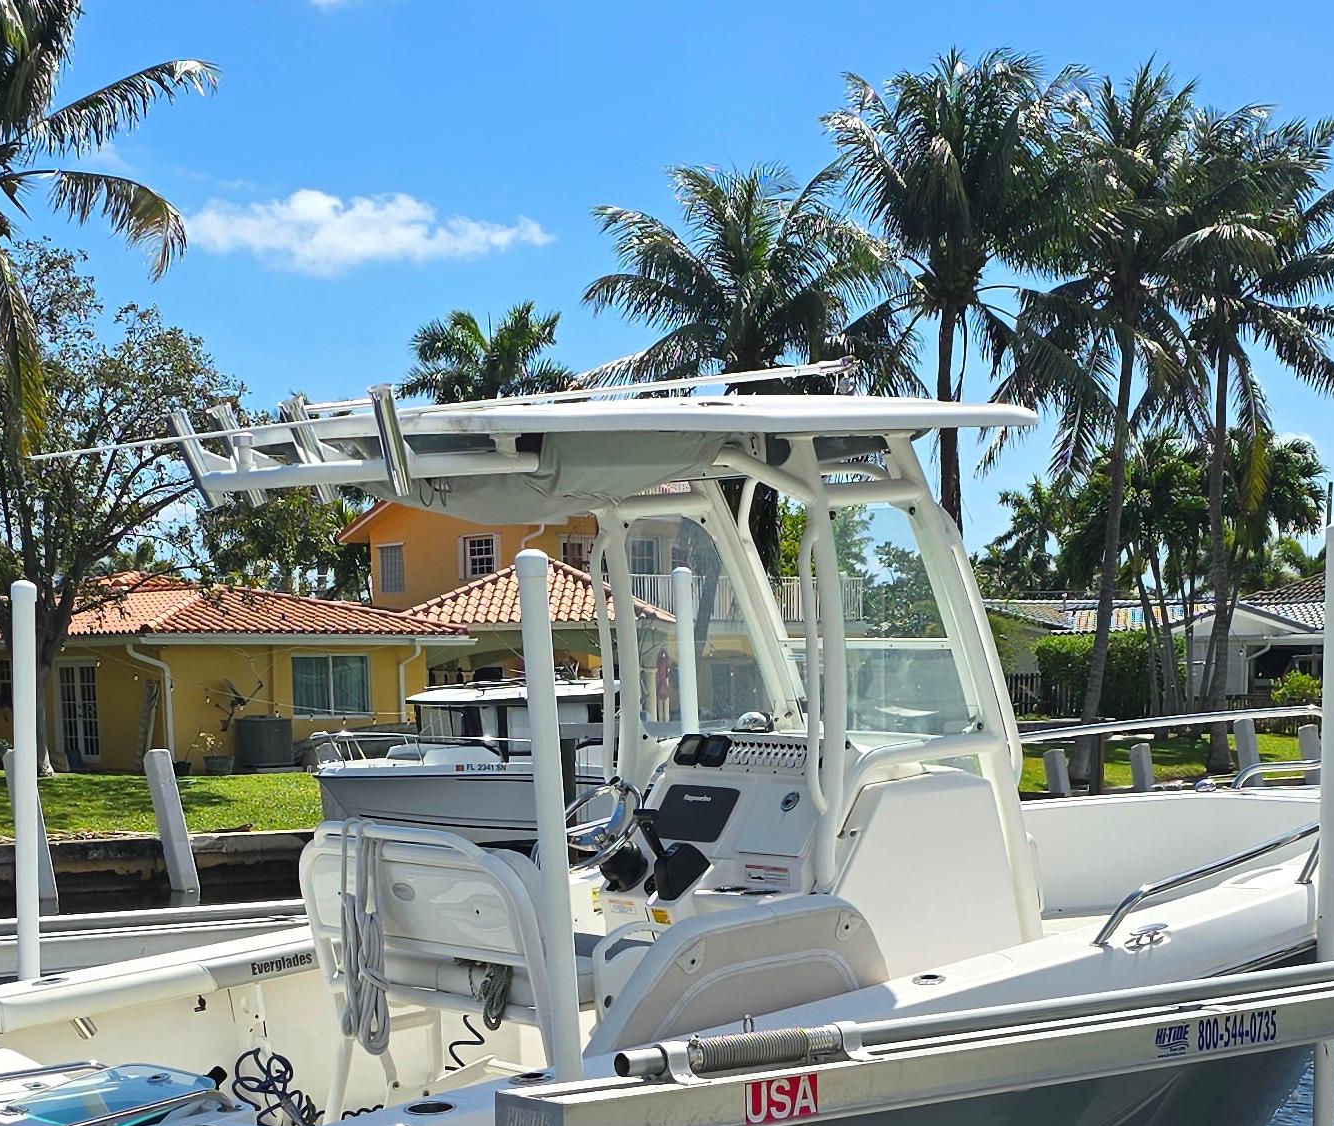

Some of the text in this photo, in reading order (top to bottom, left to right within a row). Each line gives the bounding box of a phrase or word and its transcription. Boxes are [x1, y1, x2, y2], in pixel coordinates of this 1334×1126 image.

[251, 953, 313, 976] Everglades
[1198, 1009, 1277, 1051] 800-544-0735
[746, 1075, 817, 1123] USA
